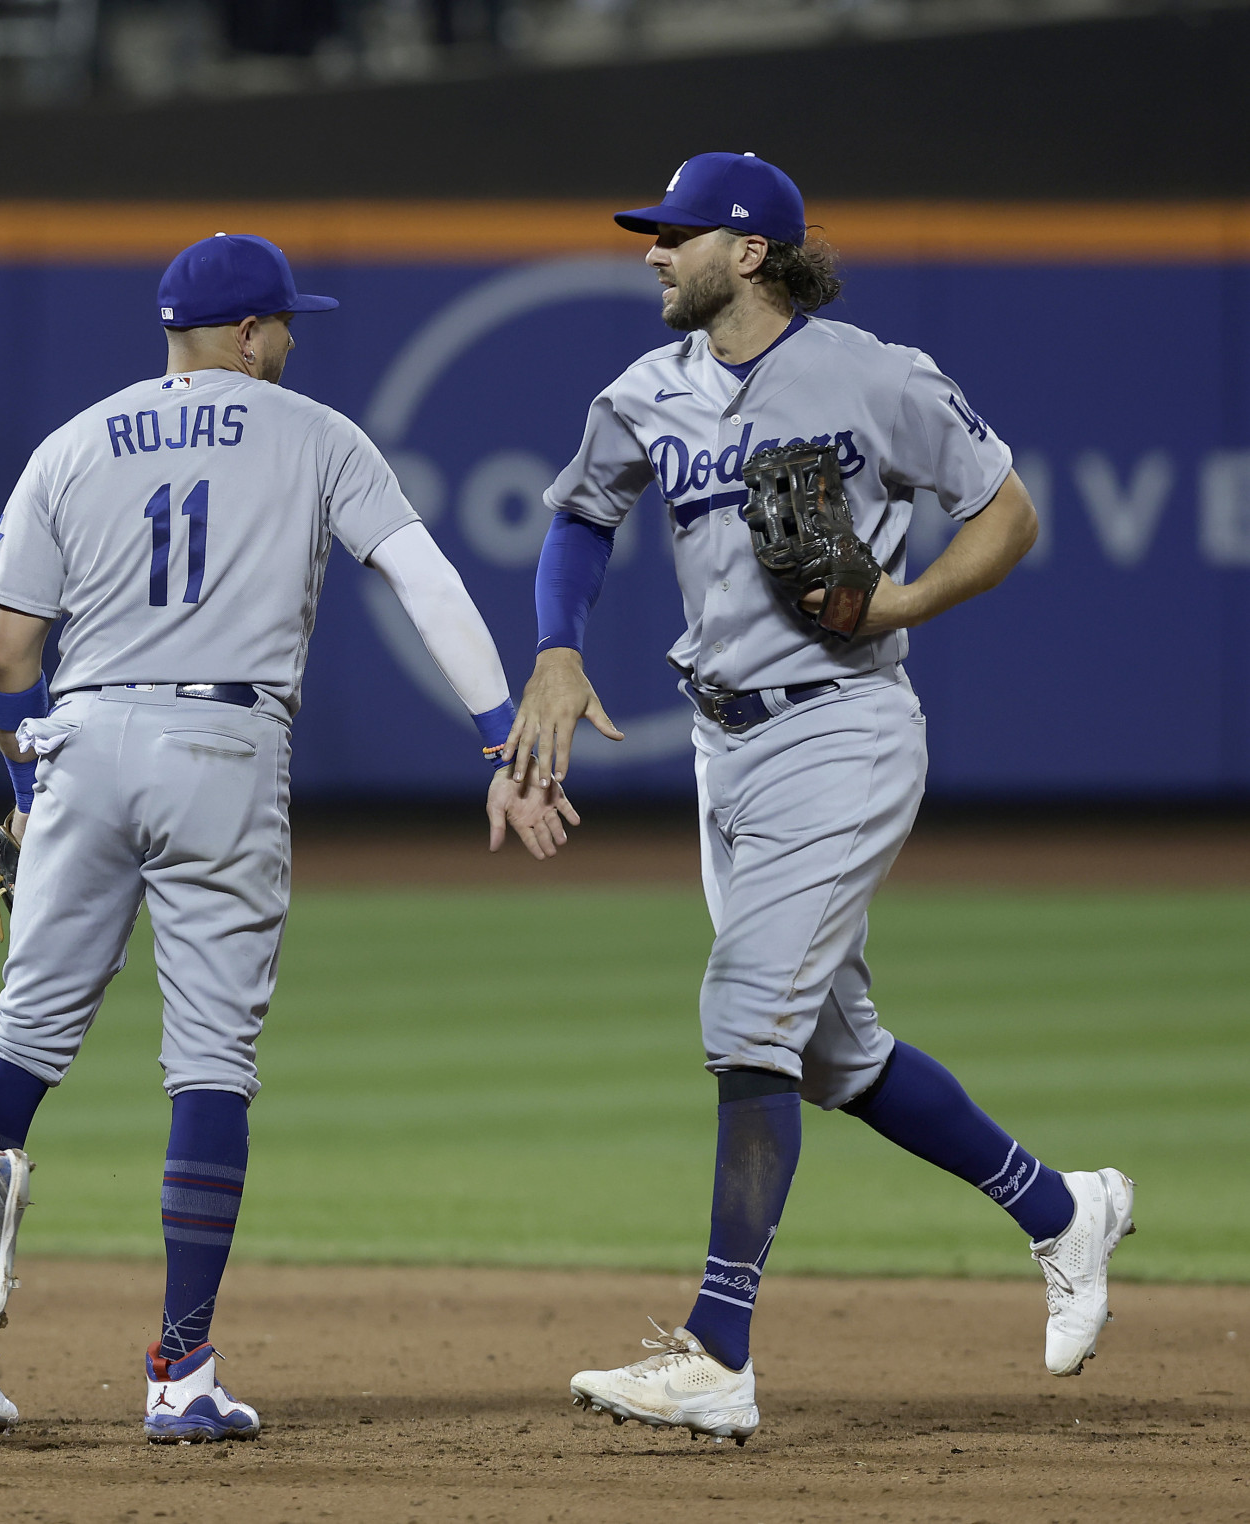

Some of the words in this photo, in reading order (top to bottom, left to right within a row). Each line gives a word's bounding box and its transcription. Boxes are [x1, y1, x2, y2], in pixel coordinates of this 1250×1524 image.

[106, 404, 249, 458] ROJAS
[144, 479, 210, 607] 11
[989, 1161, 1028, 1200] Dodgers
